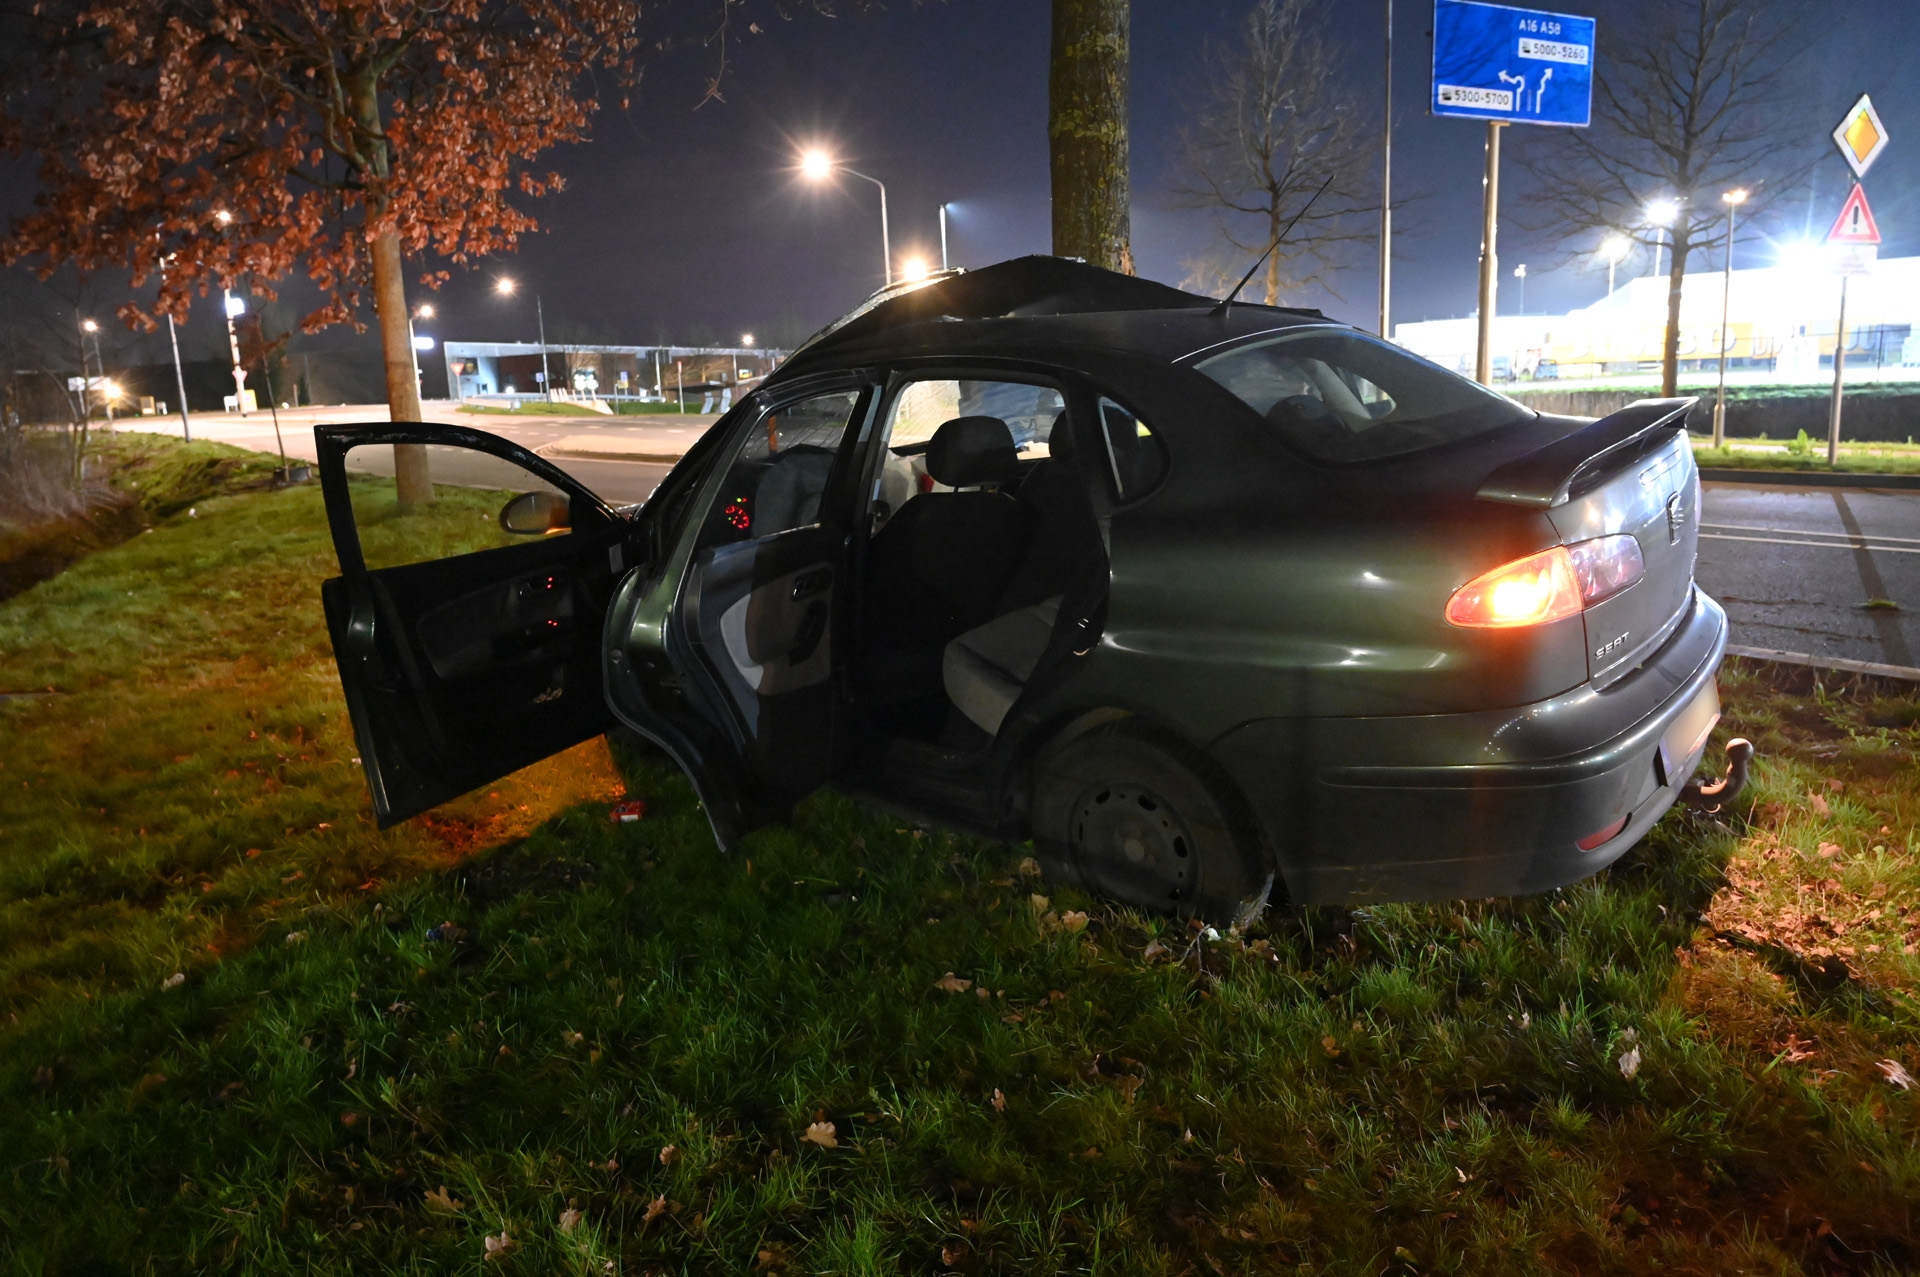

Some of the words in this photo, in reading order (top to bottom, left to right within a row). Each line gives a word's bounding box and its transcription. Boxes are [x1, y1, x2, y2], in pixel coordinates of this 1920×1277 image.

[1519, 19, 1538, 32] A16
[1540, 22, 1561, 35] A58
[1533, 43, 1585, 60] 5000-5260
[1454, 90, 1509, 106] 5300-5700
[1594, 631, 1630, 661] SEAT
